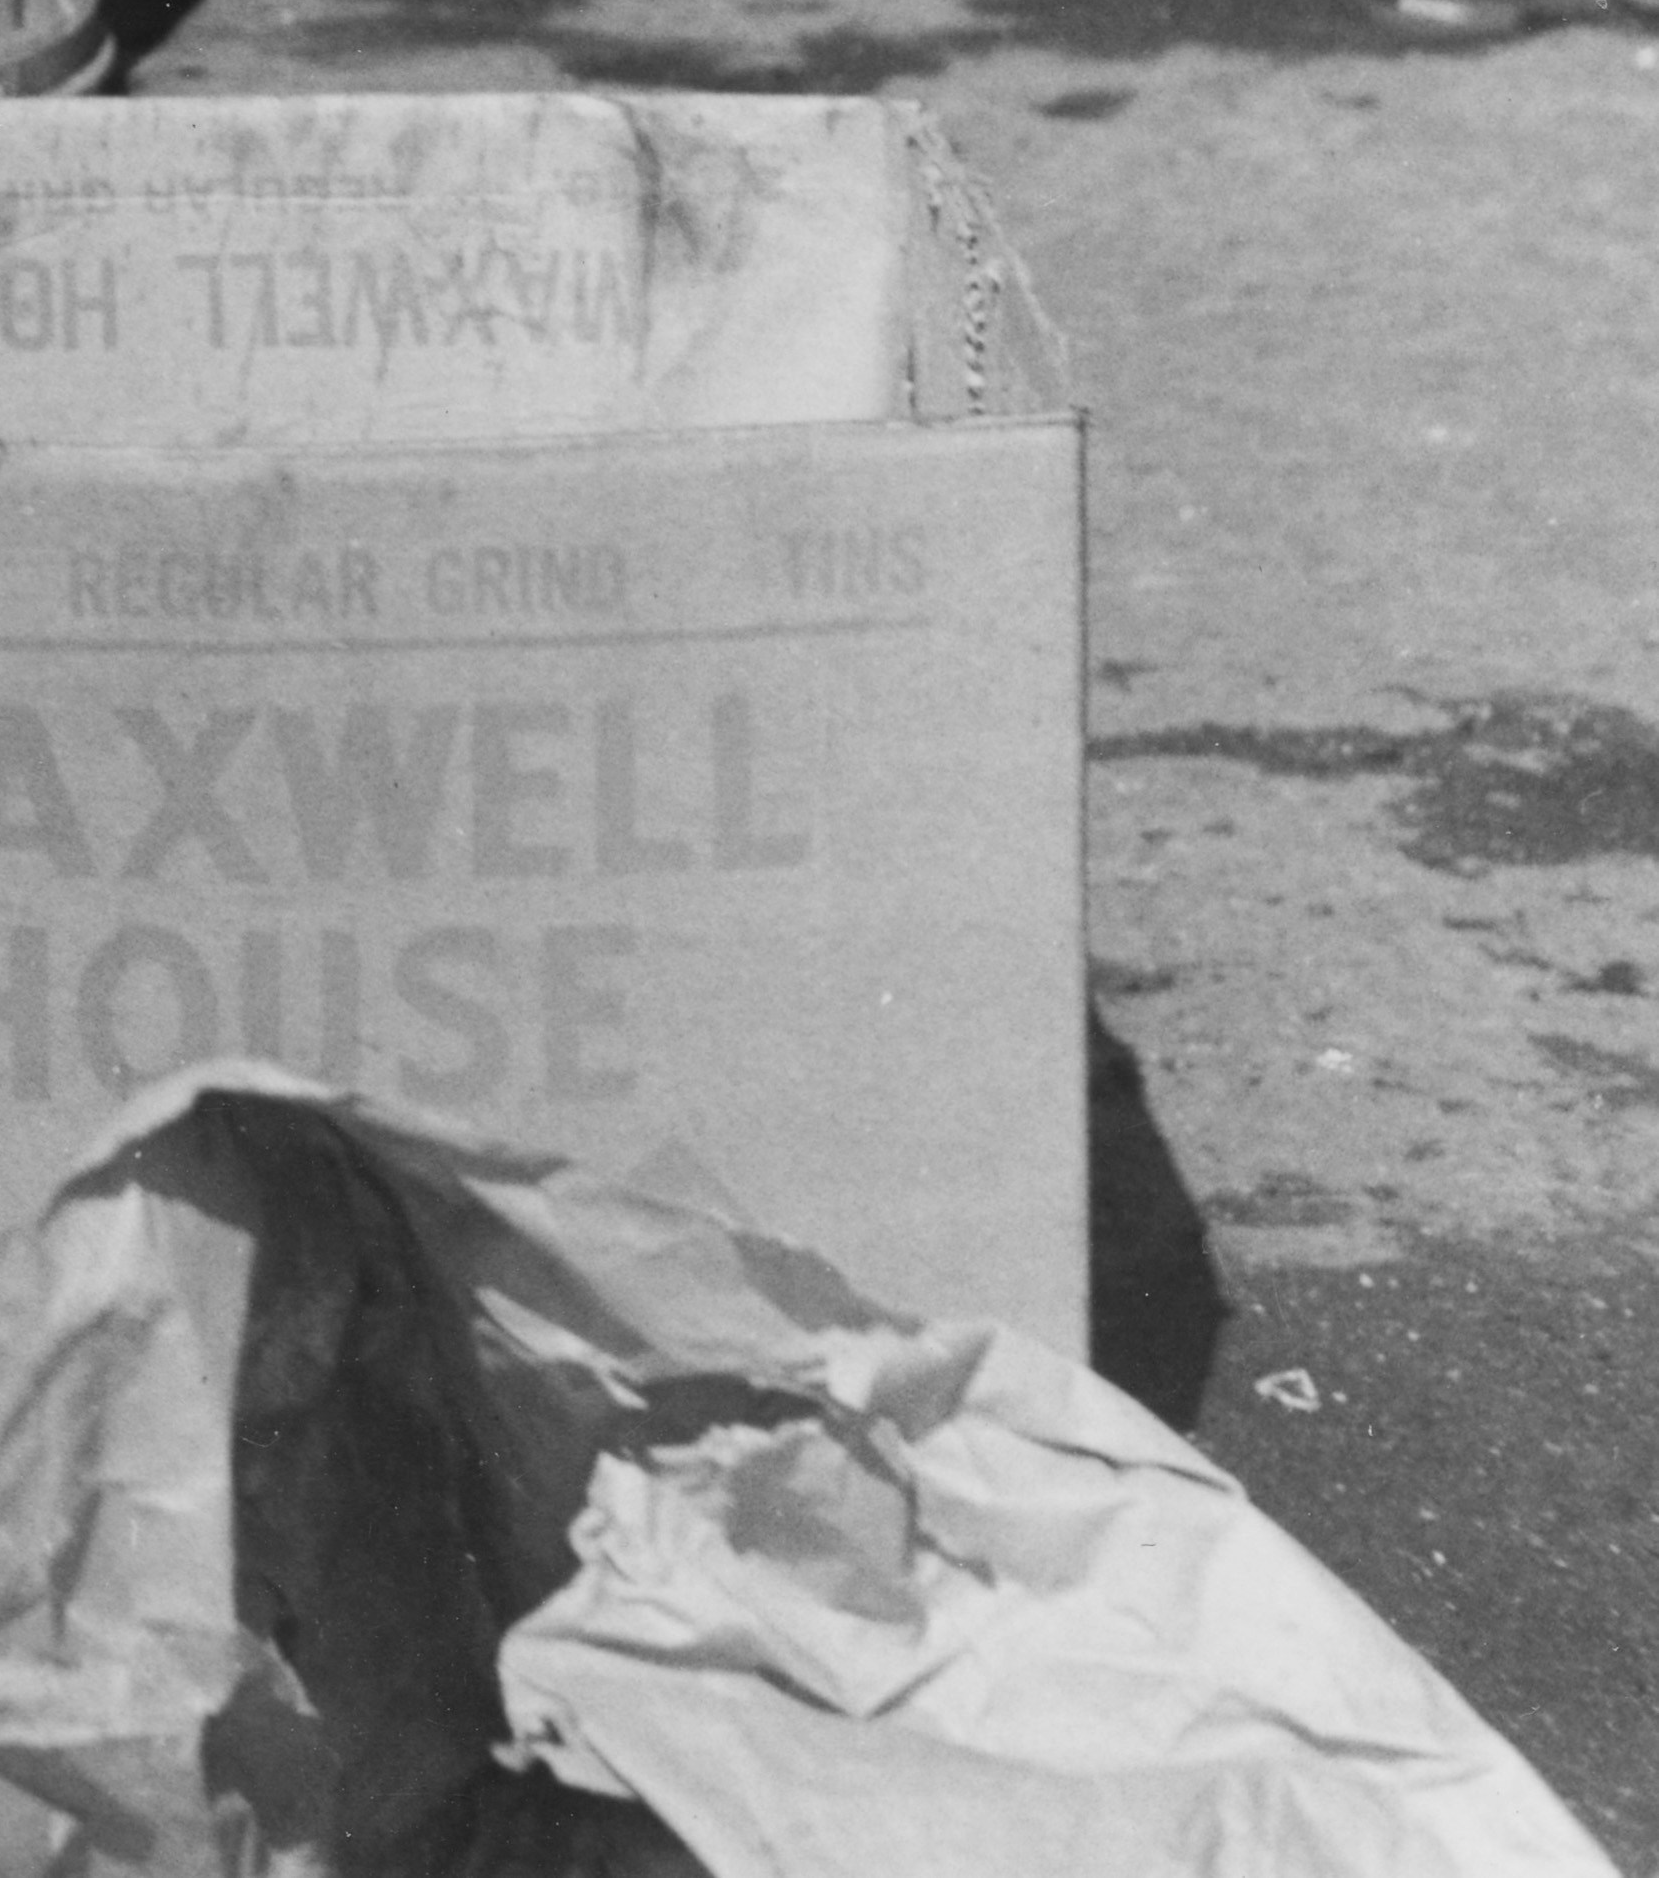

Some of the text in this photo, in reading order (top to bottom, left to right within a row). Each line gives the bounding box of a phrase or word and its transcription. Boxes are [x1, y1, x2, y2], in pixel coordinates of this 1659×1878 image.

[69, 542, 379, 620] REGULAR
[423, 543, 628, 616] GRIND
[775, 524, 928, 599] TINS
